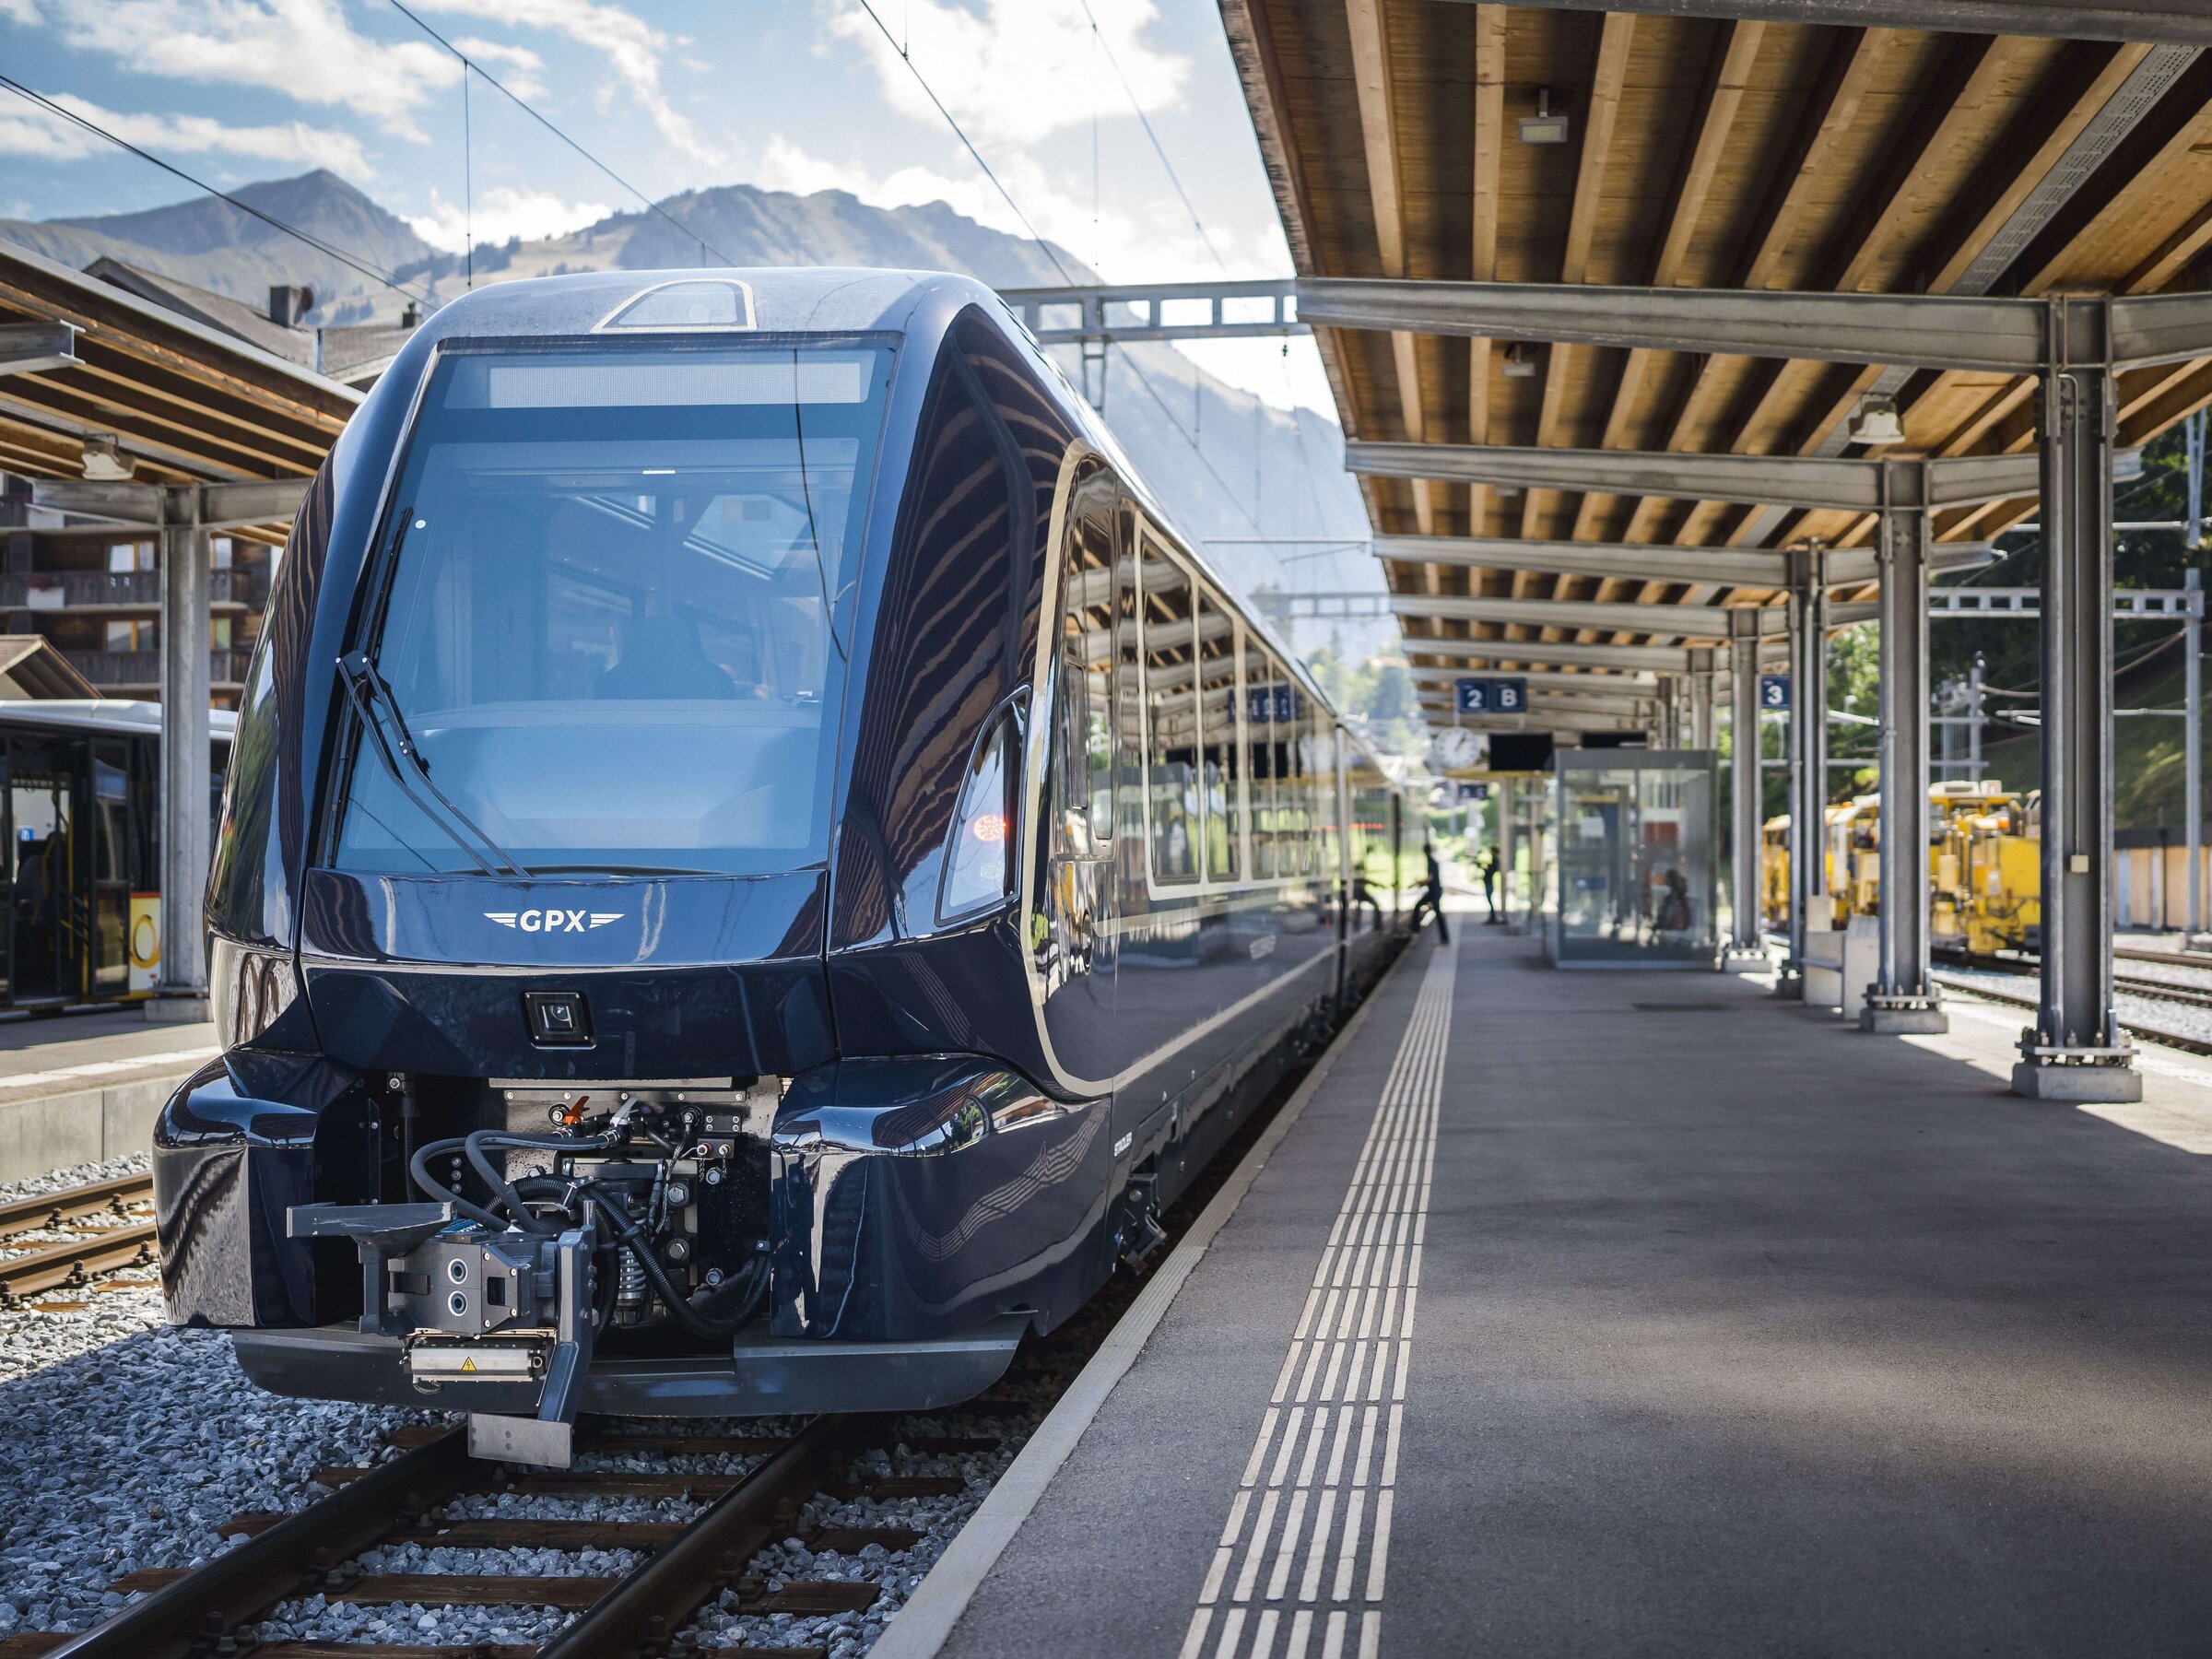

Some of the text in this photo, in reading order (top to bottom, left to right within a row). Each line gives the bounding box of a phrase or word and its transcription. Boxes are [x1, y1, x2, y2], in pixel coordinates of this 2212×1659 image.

[1467, 688, 1517, 708] 2 B
[1767, 685, 1783, 704] 3
[520, 910, 586, 932] GPX
